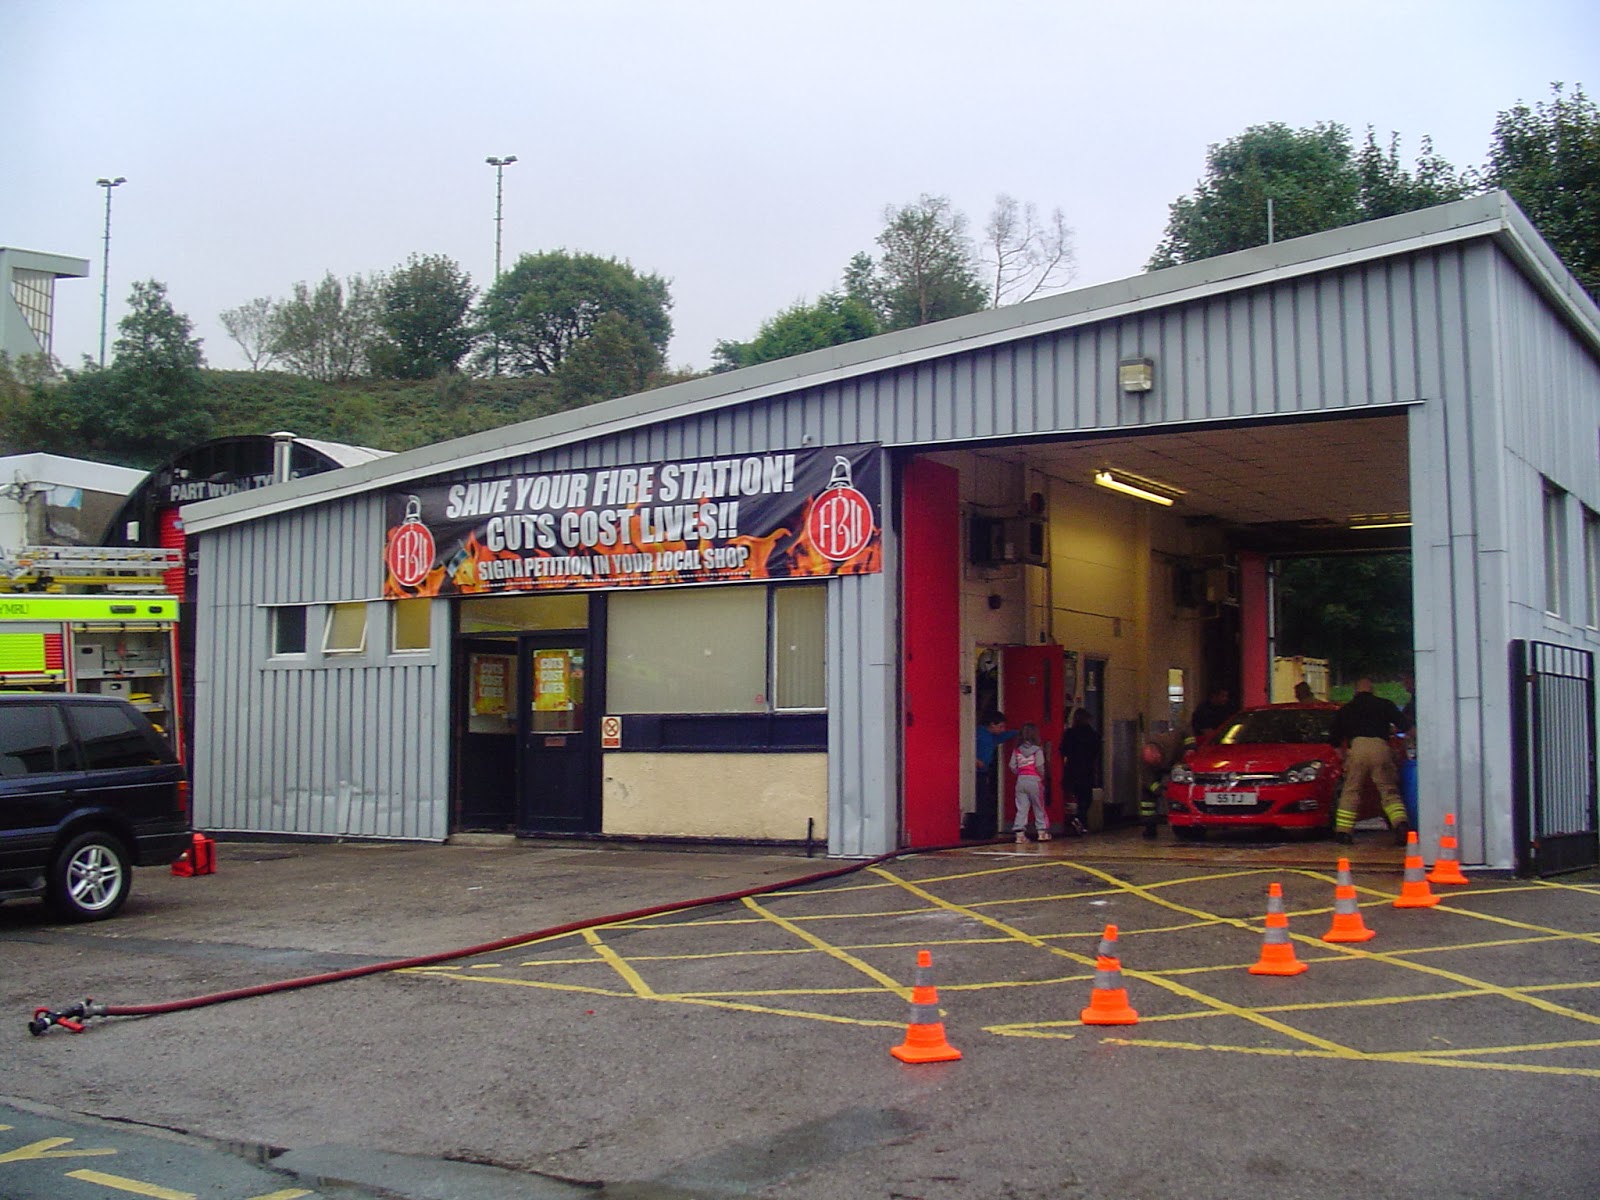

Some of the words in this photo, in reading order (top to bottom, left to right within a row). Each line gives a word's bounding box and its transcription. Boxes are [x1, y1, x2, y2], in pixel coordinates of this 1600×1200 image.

[170, 481, 206, 501] PART
[446, 479, 510, 519] SAVE
[514, 473, 588, 511] YOUR
[592, 466, 655, 506] FIRE
[659, 454, 796, 502] STATION!
[486, 513, 556, 552] CUTS
[560, 508, 634, 548] COST
[639, 501, 740, 544] LIVES!!
[478, 558, 513, 581] SIGN
[514, 558, 524, 578] A
[524, 556, 592, 578] PETITION
[594, 553, 611, 575] IN
[613, 551, 653, 574] YOUR
[656, 549, 702, 572] LOCAL
[702, 546, 749, 570] SHOP
